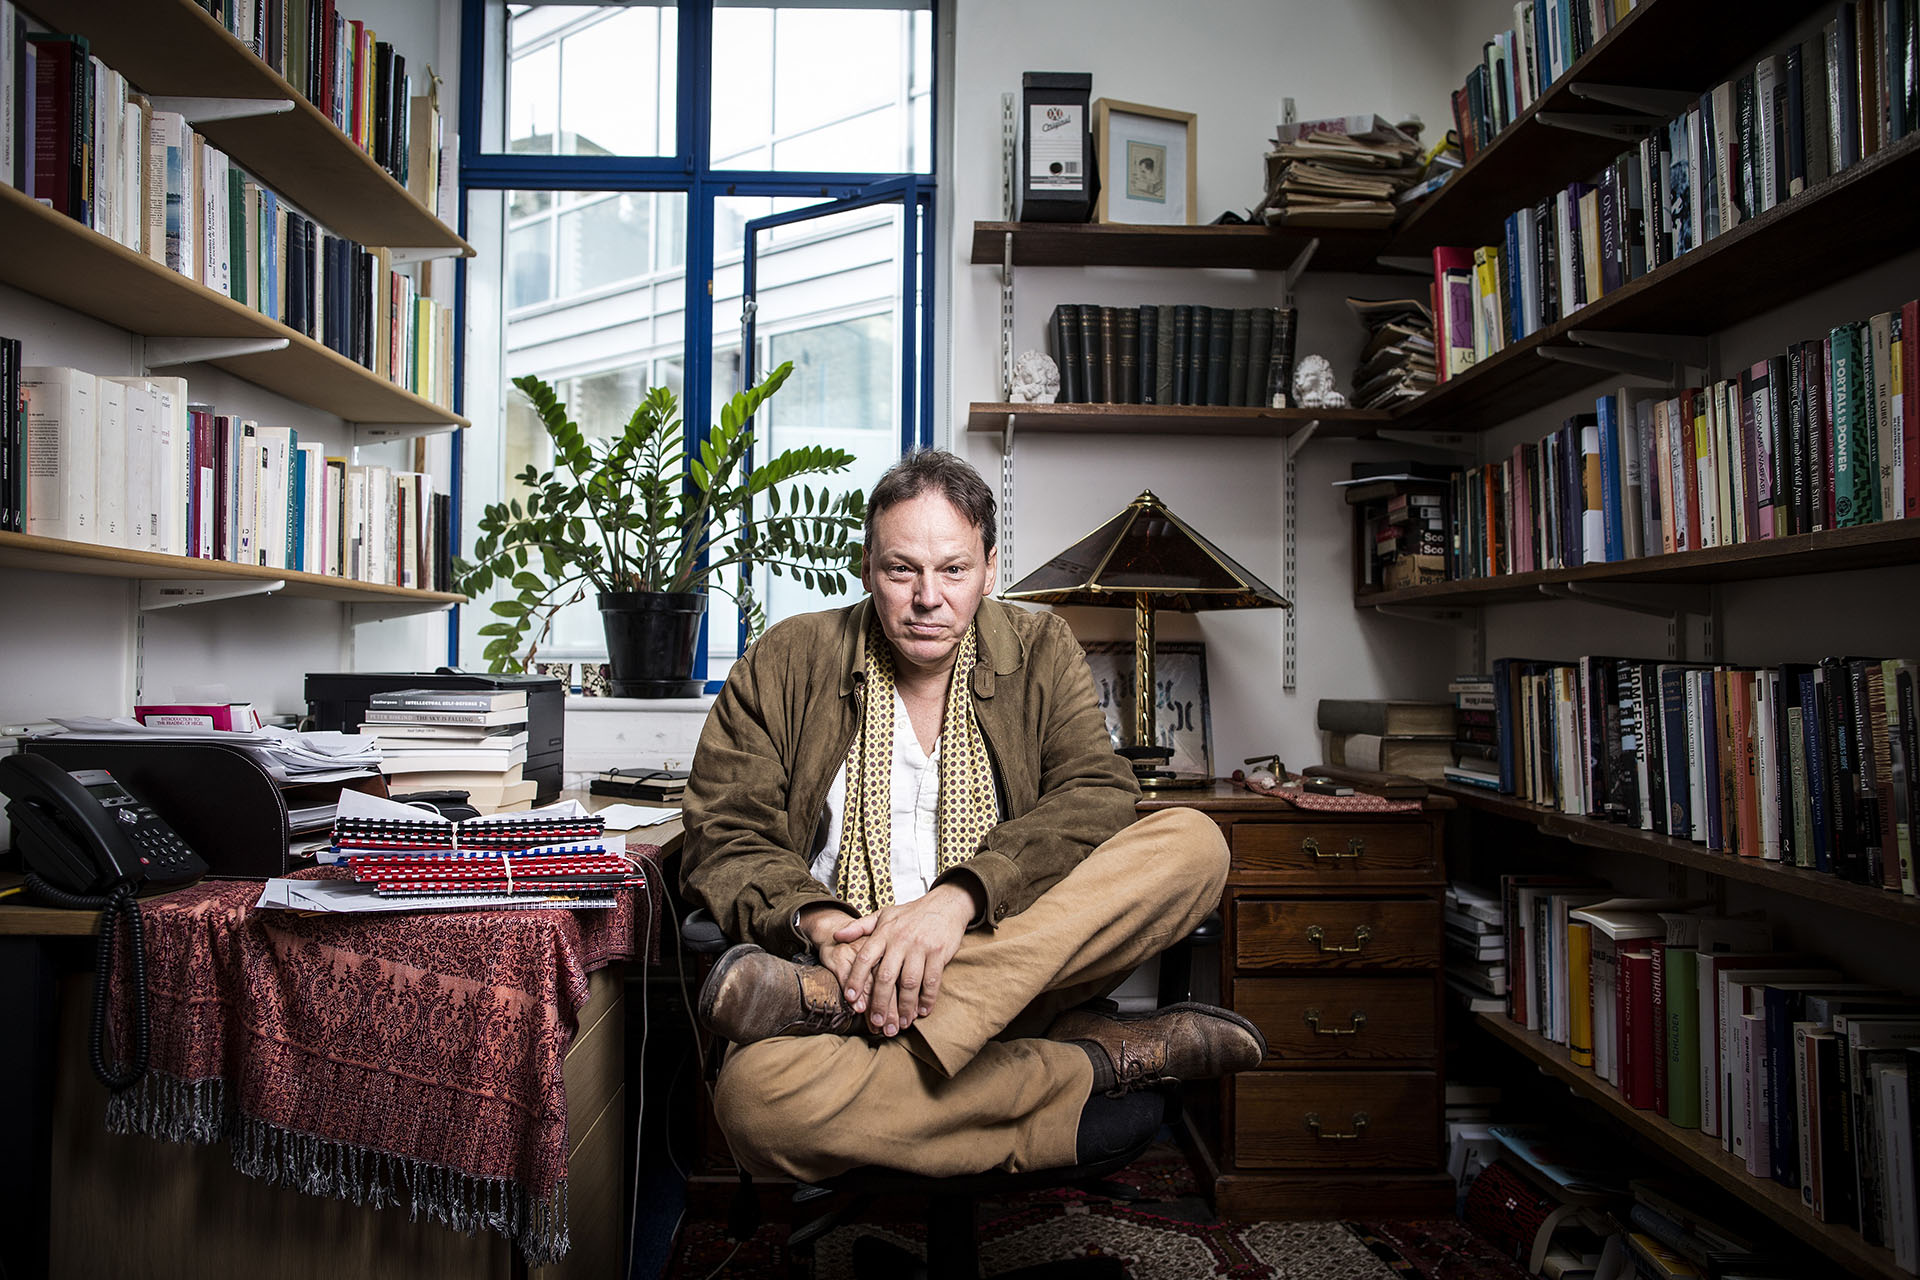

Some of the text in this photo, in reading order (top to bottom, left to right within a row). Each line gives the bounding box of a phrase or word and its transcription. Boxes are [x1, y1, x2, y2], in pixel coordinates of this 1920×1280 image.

[1742, 106, 1751, 126] The
[1742, 127, 1751, 160] Forest
[1602, 194, 1614, 260] ON KINGS
[1836, 358, 1848, 473] PORTALS & POWER
[1879, 384, 1888, 427] THE CUBEO
[1671, 448, 1680, 469] God
[1755, 393, 1766, 496] YANOMAMI WARFARE
[1794, 467, 1802, 486] Wild
[1793, 487, 1801, 506] Man
[1812, 488, 1820, 511] STATE
[286, 507, 295, 553] TRADITION
[1687, 678, 1695, 709] WOMEN
[1868, 673, 1886, 707] SOCIAL
[1688, 727, 1696, 768] SACRIFICE
[1851, 672, 1869, 791] Reassembling the Social
[1840, 755, 1848, 770] HOPE
[1651, 949, 1663, 1005] SCHULDEN
[1671, 1013, 1681, 1063] SCHULDEN
